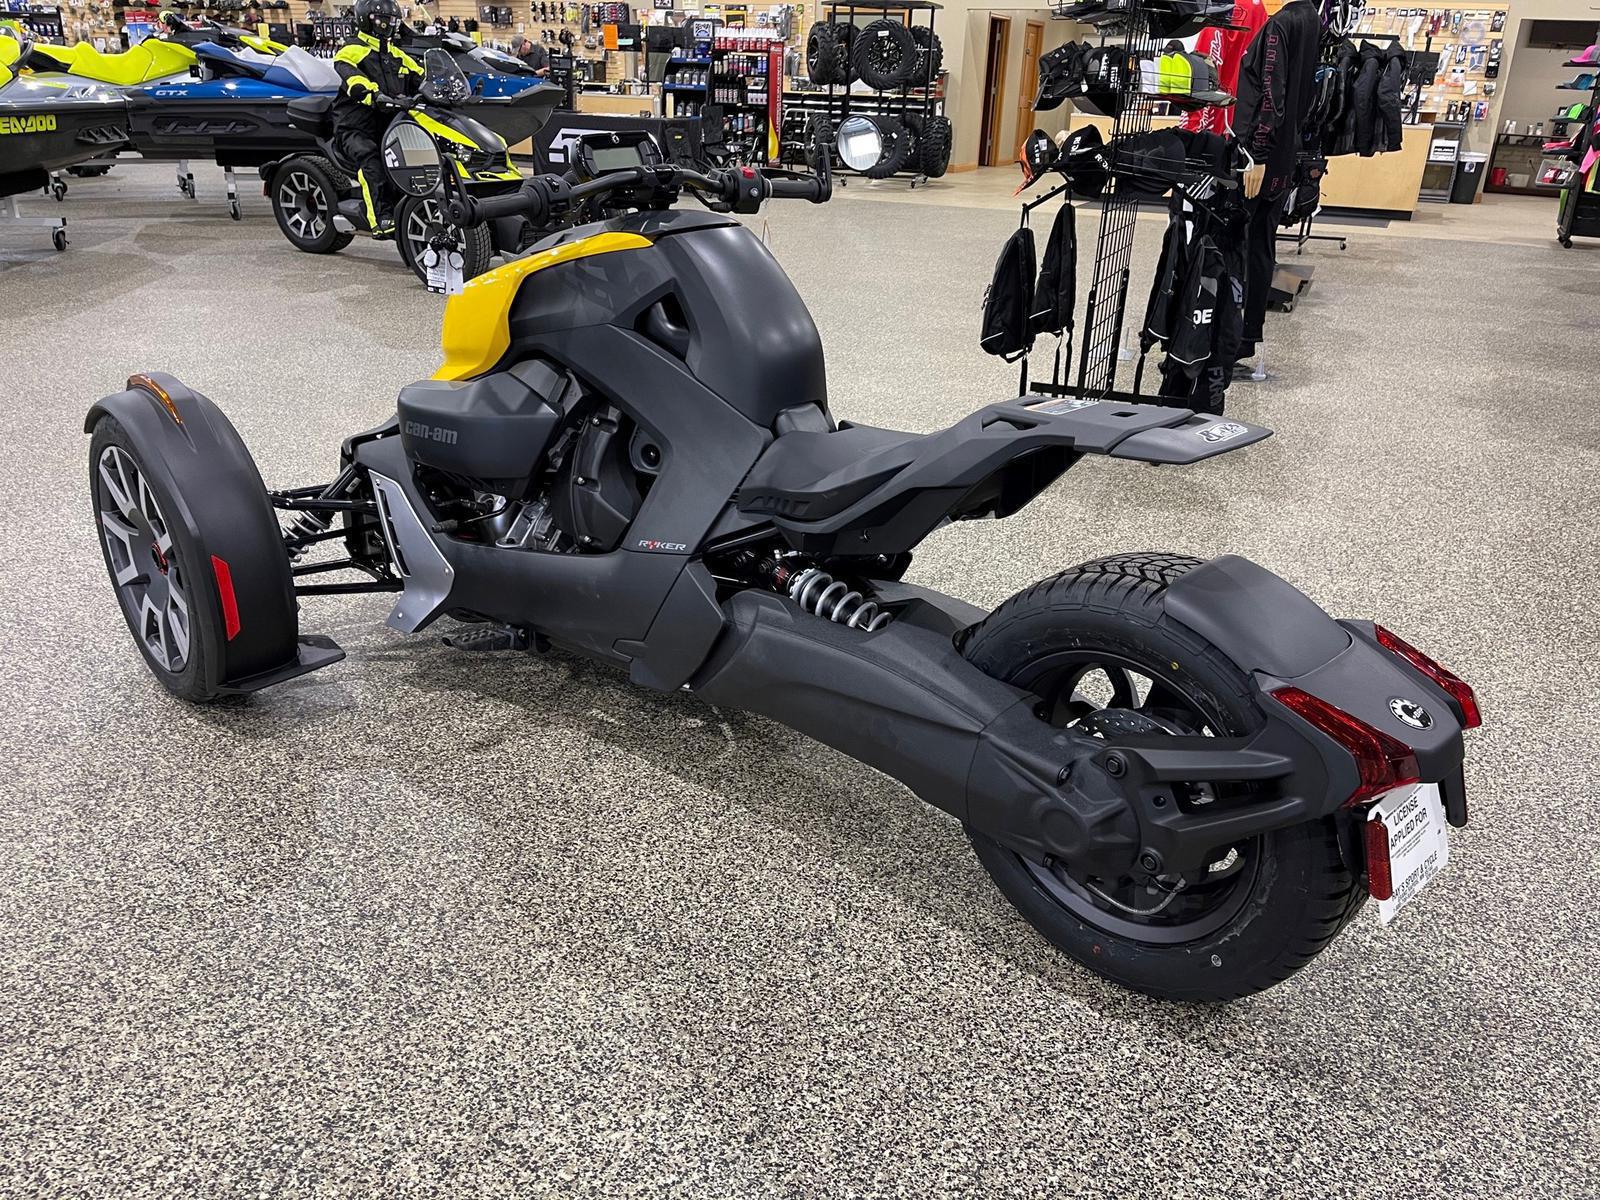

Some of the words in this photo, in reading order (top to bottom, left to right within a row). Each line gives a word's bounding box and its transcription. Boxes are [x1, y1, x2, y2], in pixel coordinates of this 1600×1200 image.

[155, 89, 189, 97] GTX
[405, 420, 458, 444] can-am
[638, 539, 687, 551] RYKER
[1393, 796, 1419, 826] LICENSE
[1390, 819, 1415, 850] APPLIED
[1415, 807, 1428, 827] FOR
